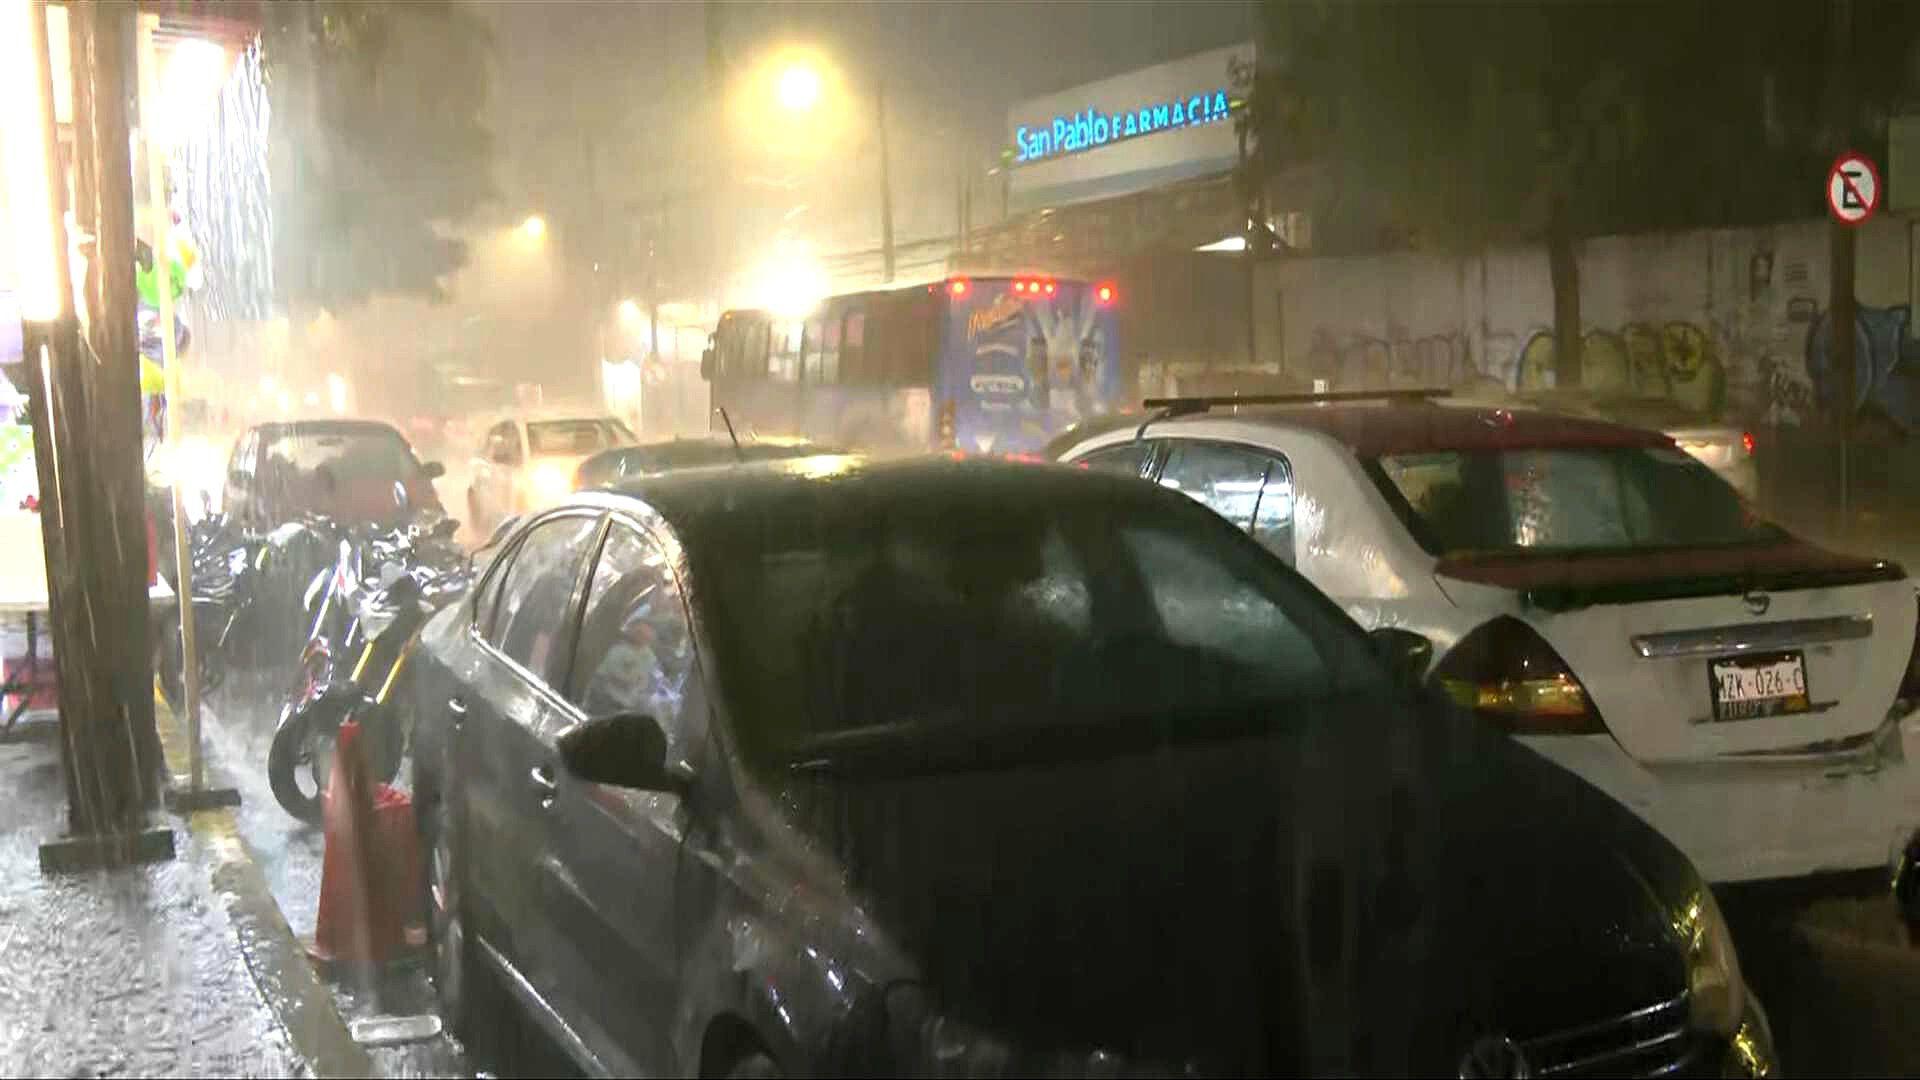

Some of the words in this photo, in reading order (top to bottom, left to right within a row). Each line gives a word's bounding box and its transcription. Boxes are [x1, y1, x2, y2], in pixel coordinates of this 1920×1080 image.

[1015, 123, 1051, 162] San
[1053, 105, 1109, 153] Pablo
[1112, 87, 1229, 139] FARMACIA
